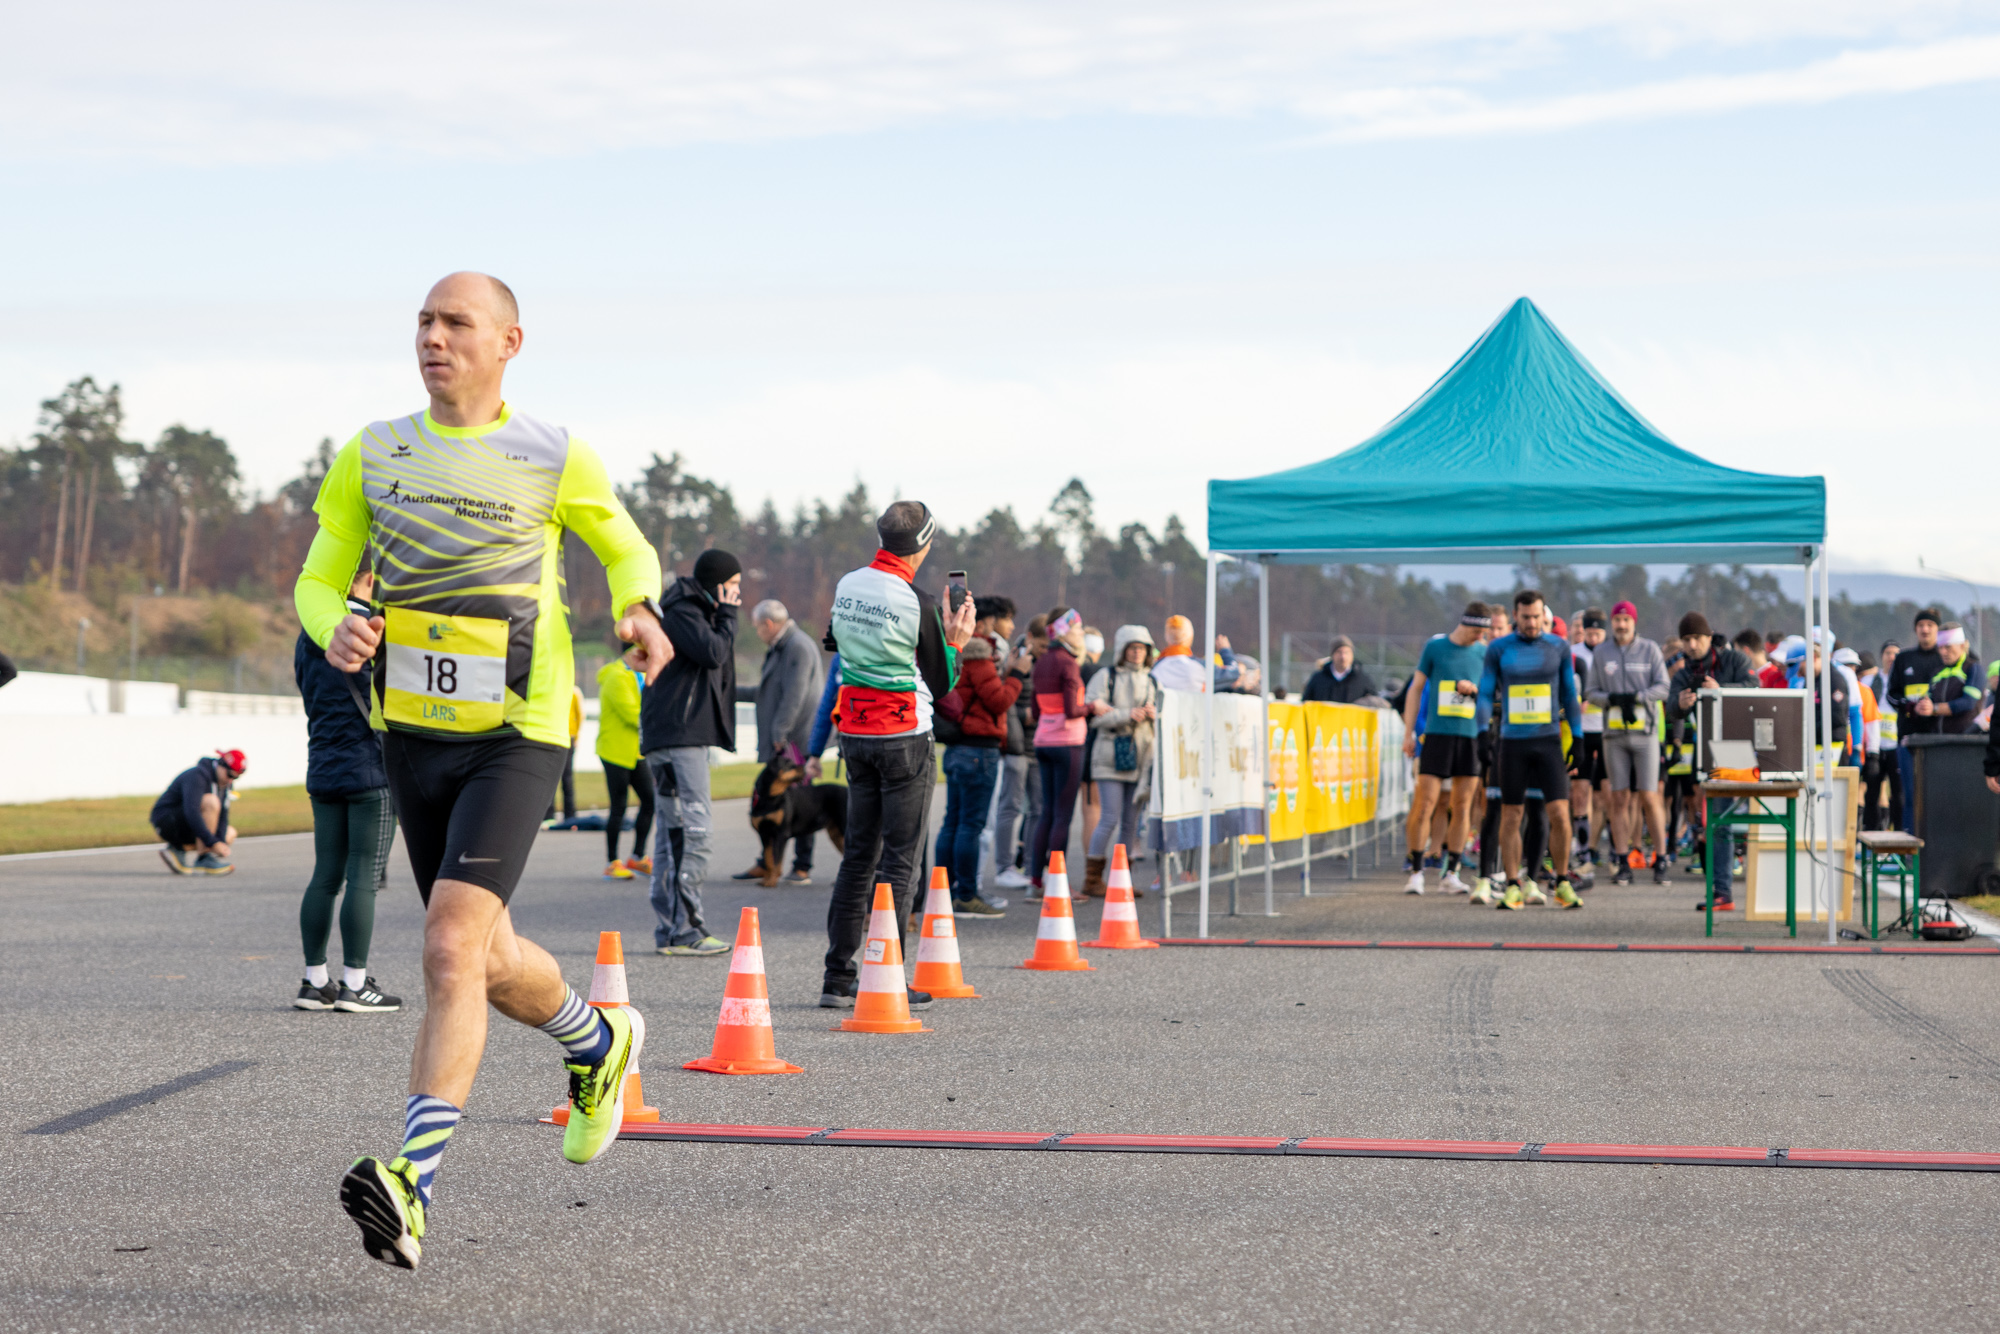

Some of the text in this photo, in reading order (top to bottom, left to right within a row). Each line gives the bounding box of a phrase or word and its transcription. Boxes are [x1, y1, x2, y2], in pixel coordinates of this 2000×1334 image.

[505, 452, 529, 462] Lars
[401, 493, 516, 513] Ausdauerteam.de
[454, 506, 513, 523] Morbach
[856, 600, 899, 623] Triathlon
[424, 654, 458, 694] 18
[423, 702, 457, 722] LARS
[1525, 698, 1535, 710] 11
